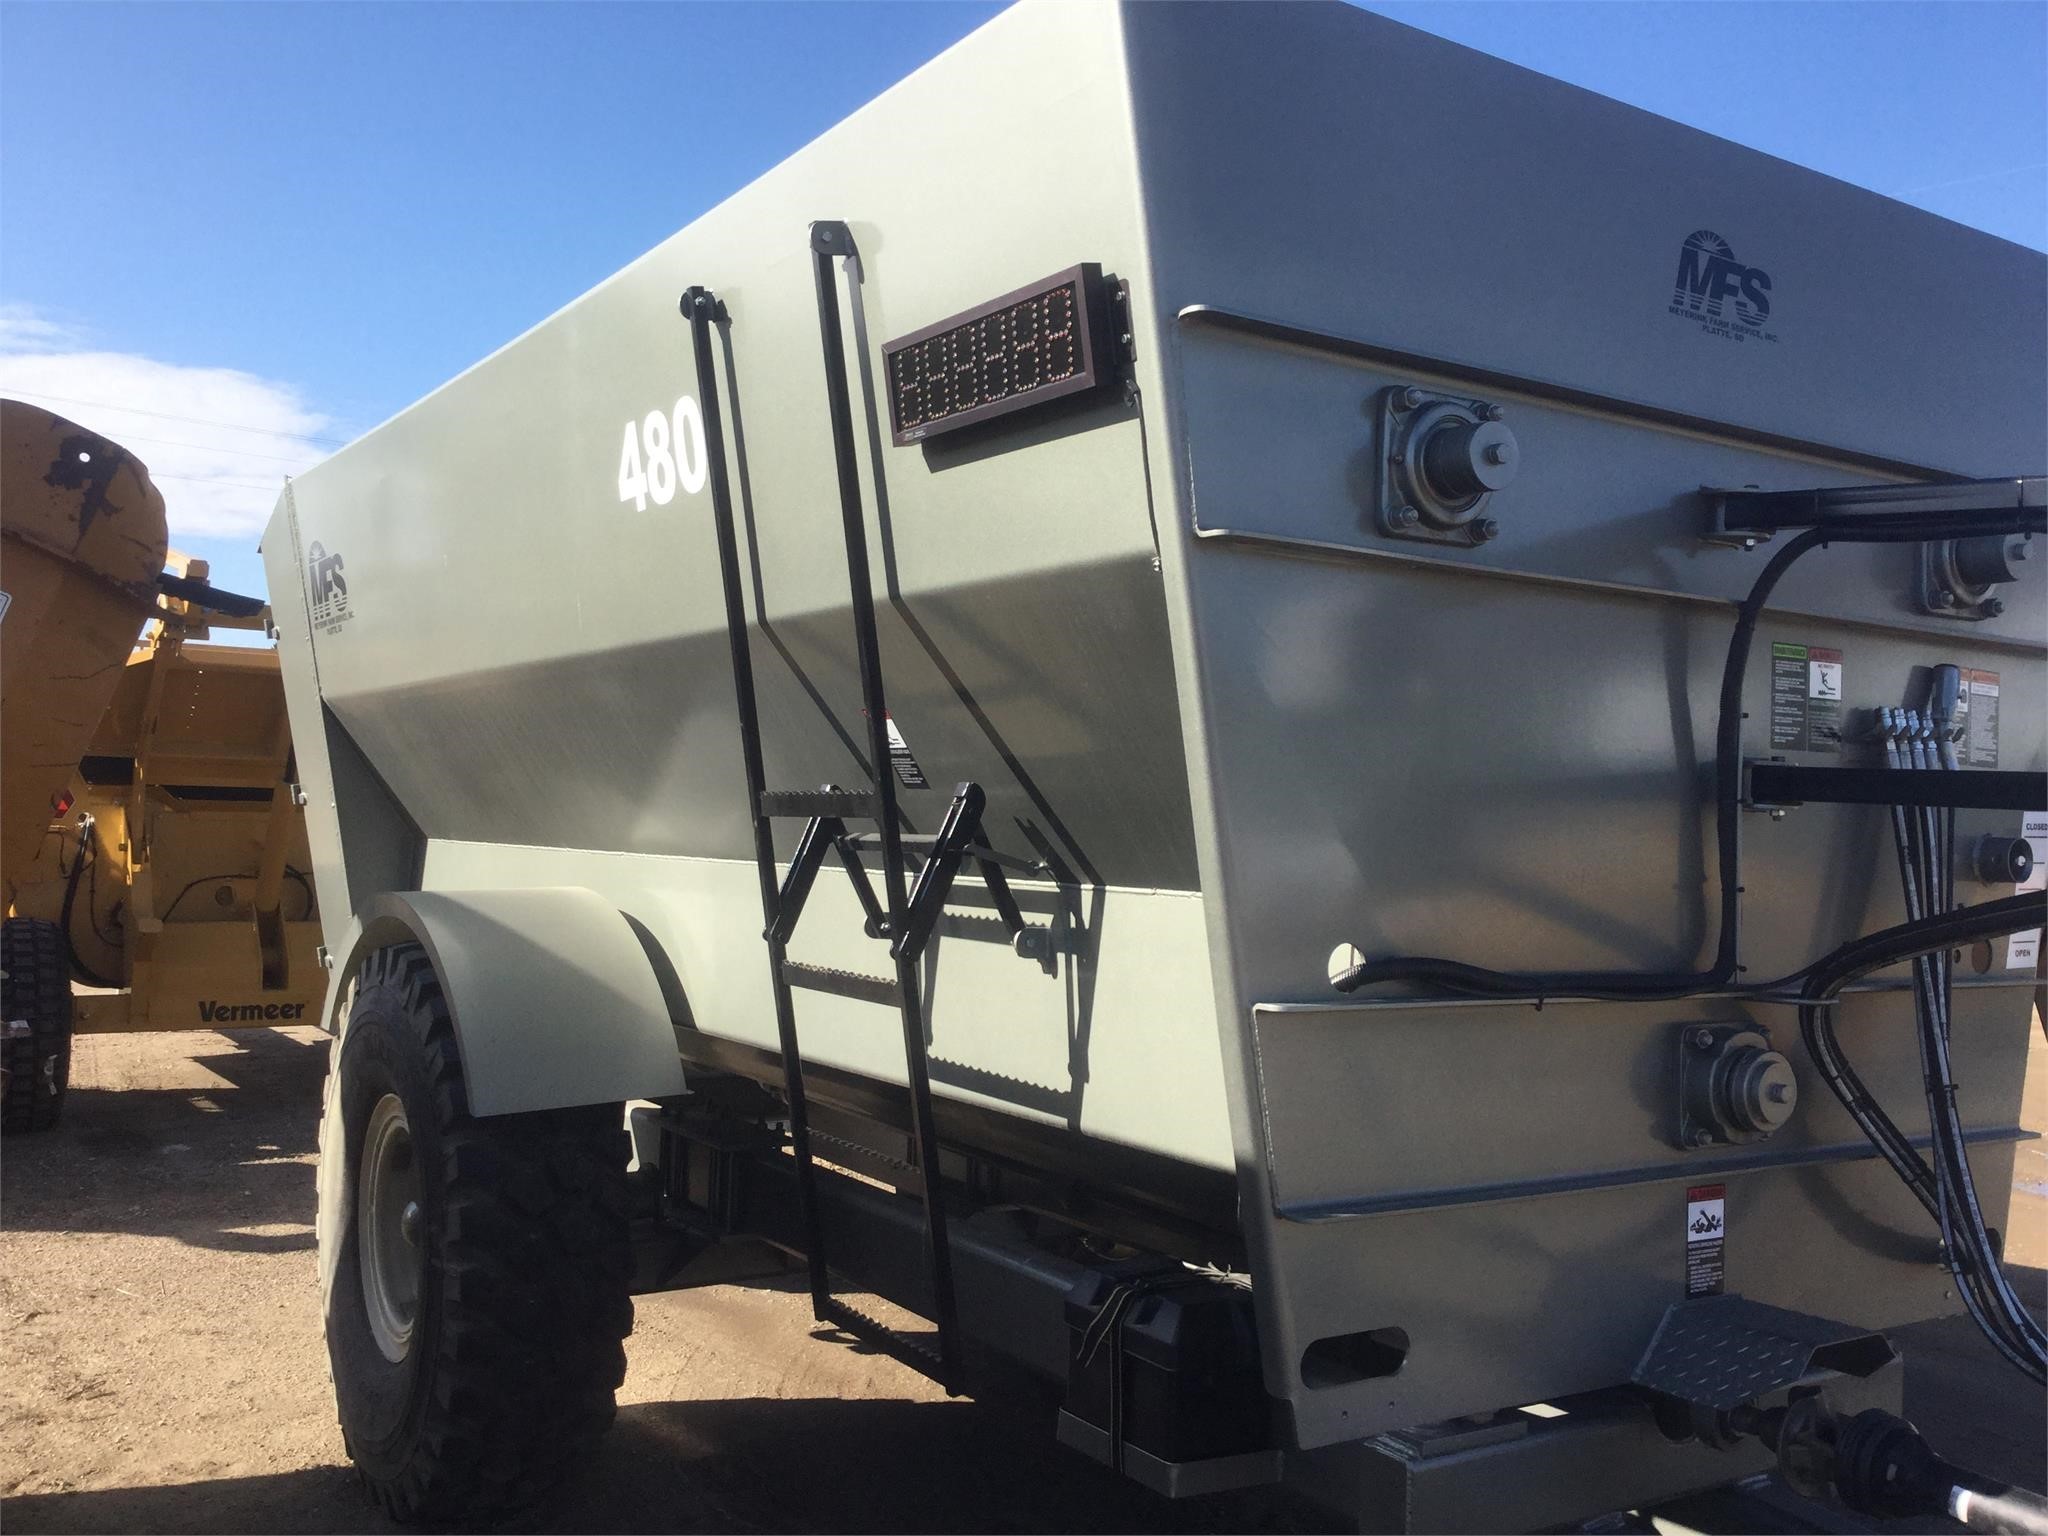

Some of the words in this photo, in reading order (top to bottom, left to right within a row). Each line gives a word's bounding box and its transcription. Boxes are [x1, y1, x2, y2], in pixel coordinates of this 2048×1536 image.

[1673, 246, 1771, 326] MFS
[618, 395, 707, 512] 480
[309, 553, 347, 620] MFS
[2015, 949, 2030, 957] OPEN
[198, 1001, 305, 1022] Vermeer
